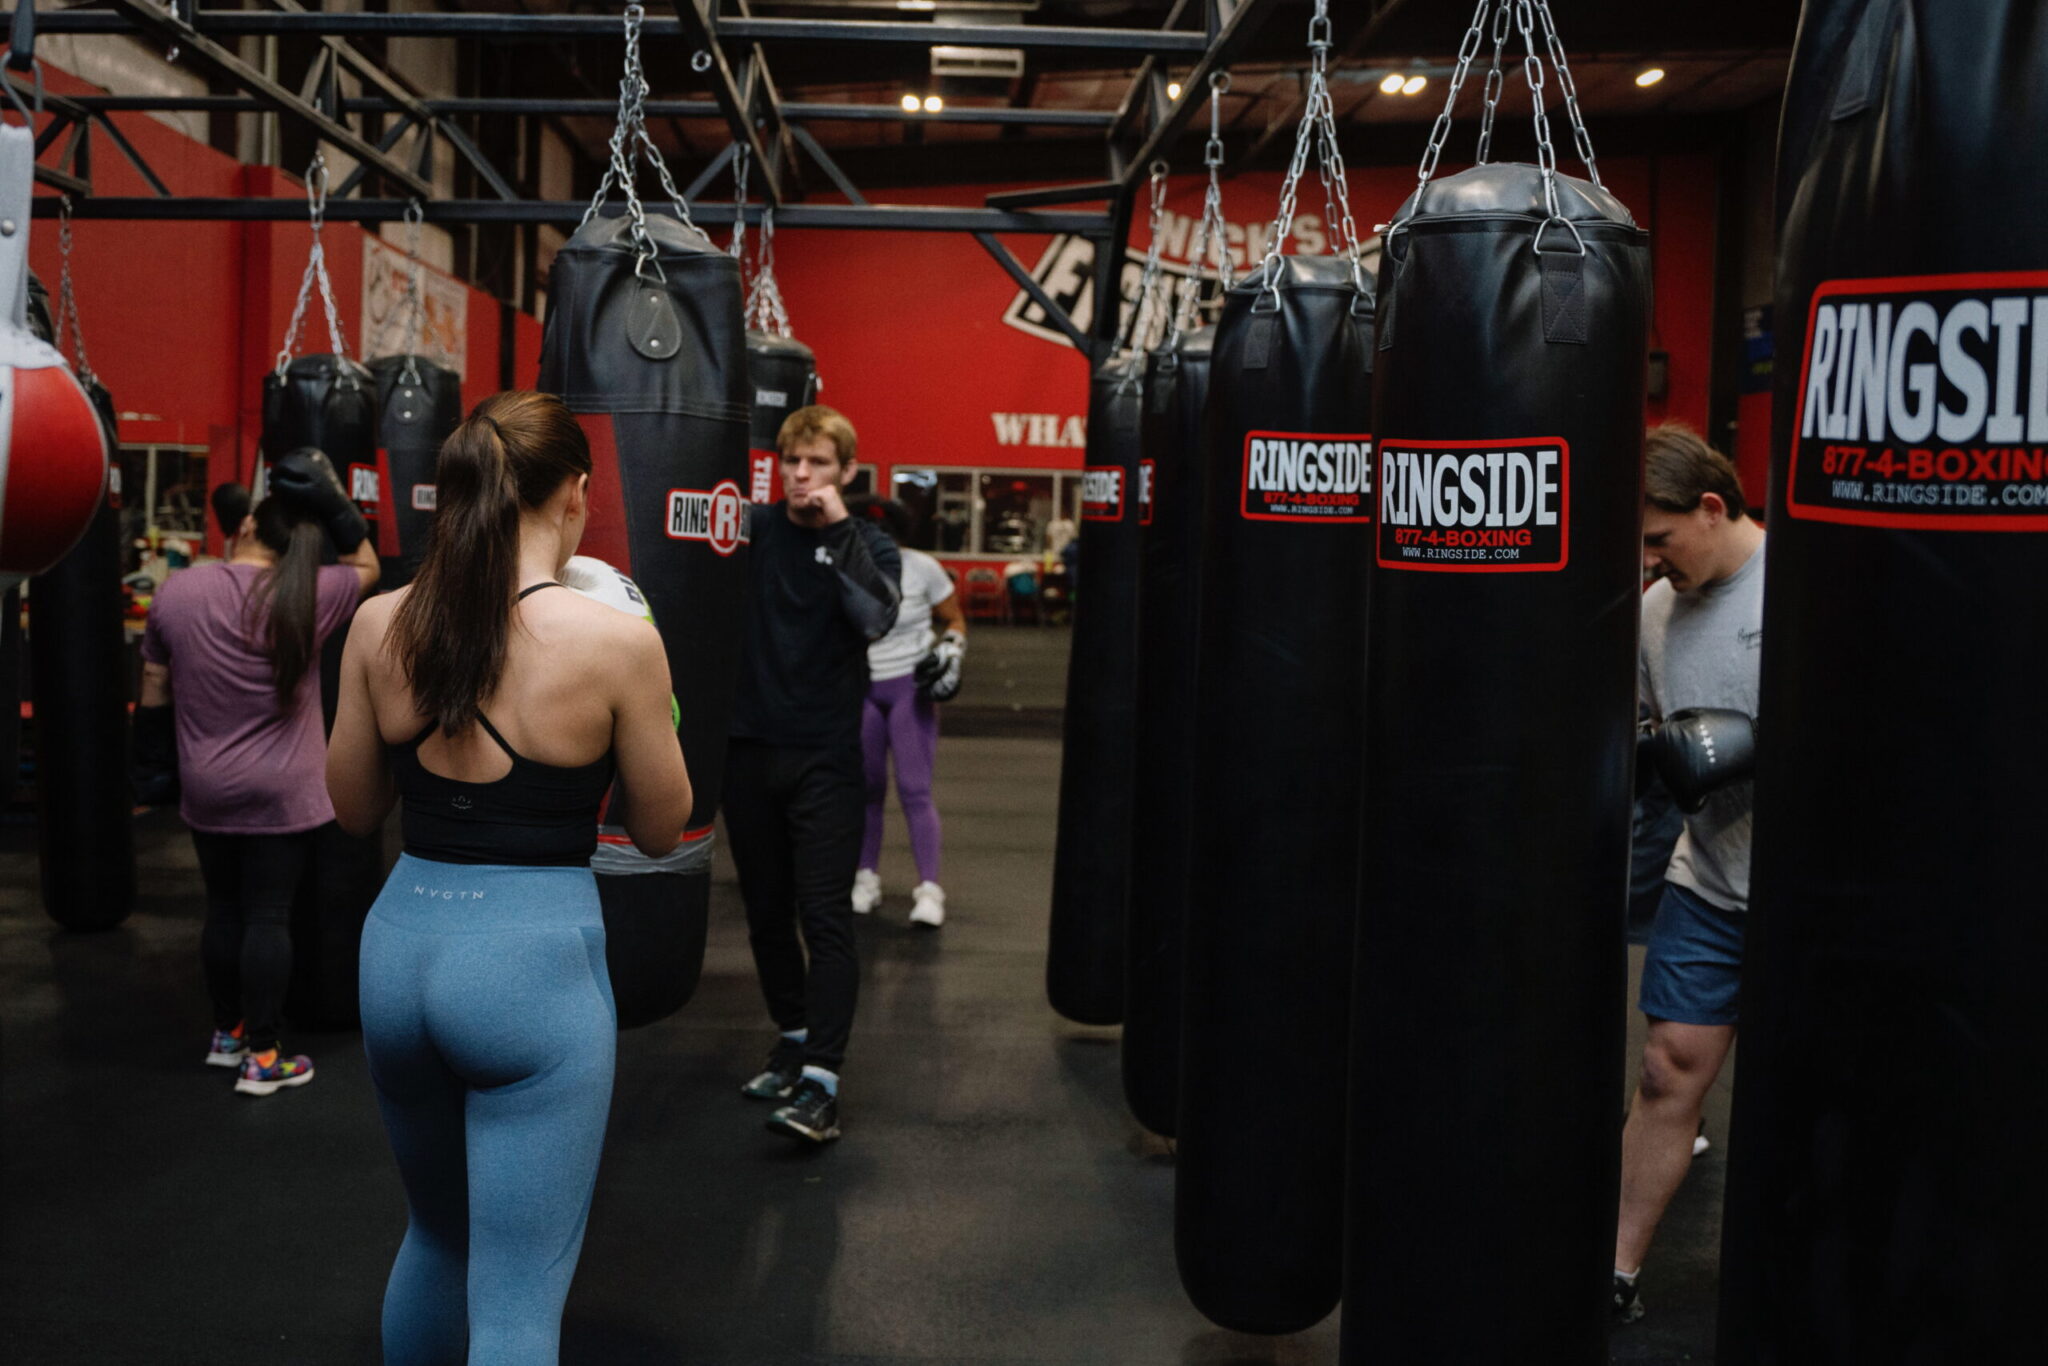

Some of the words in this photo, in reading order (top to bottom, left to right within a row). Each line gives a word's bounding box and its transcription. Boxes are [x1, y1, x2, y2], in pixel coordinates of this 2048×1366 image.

[1248, 439, 1371, 494] RINGSIDE
[1263, 491, 1360, 506] 877-4-BOXING
[1381, 450, 1558, 527] RINGSIDE
[1832, 480, 2048, 506] WWW.RINGSIDE.COM
[672, 496, 709, 534] RING
[1394, 528, 1532, 547] 877-4-BOXING
[1402, 546, 1520, 560] WWW.RINGSIDE.COM
